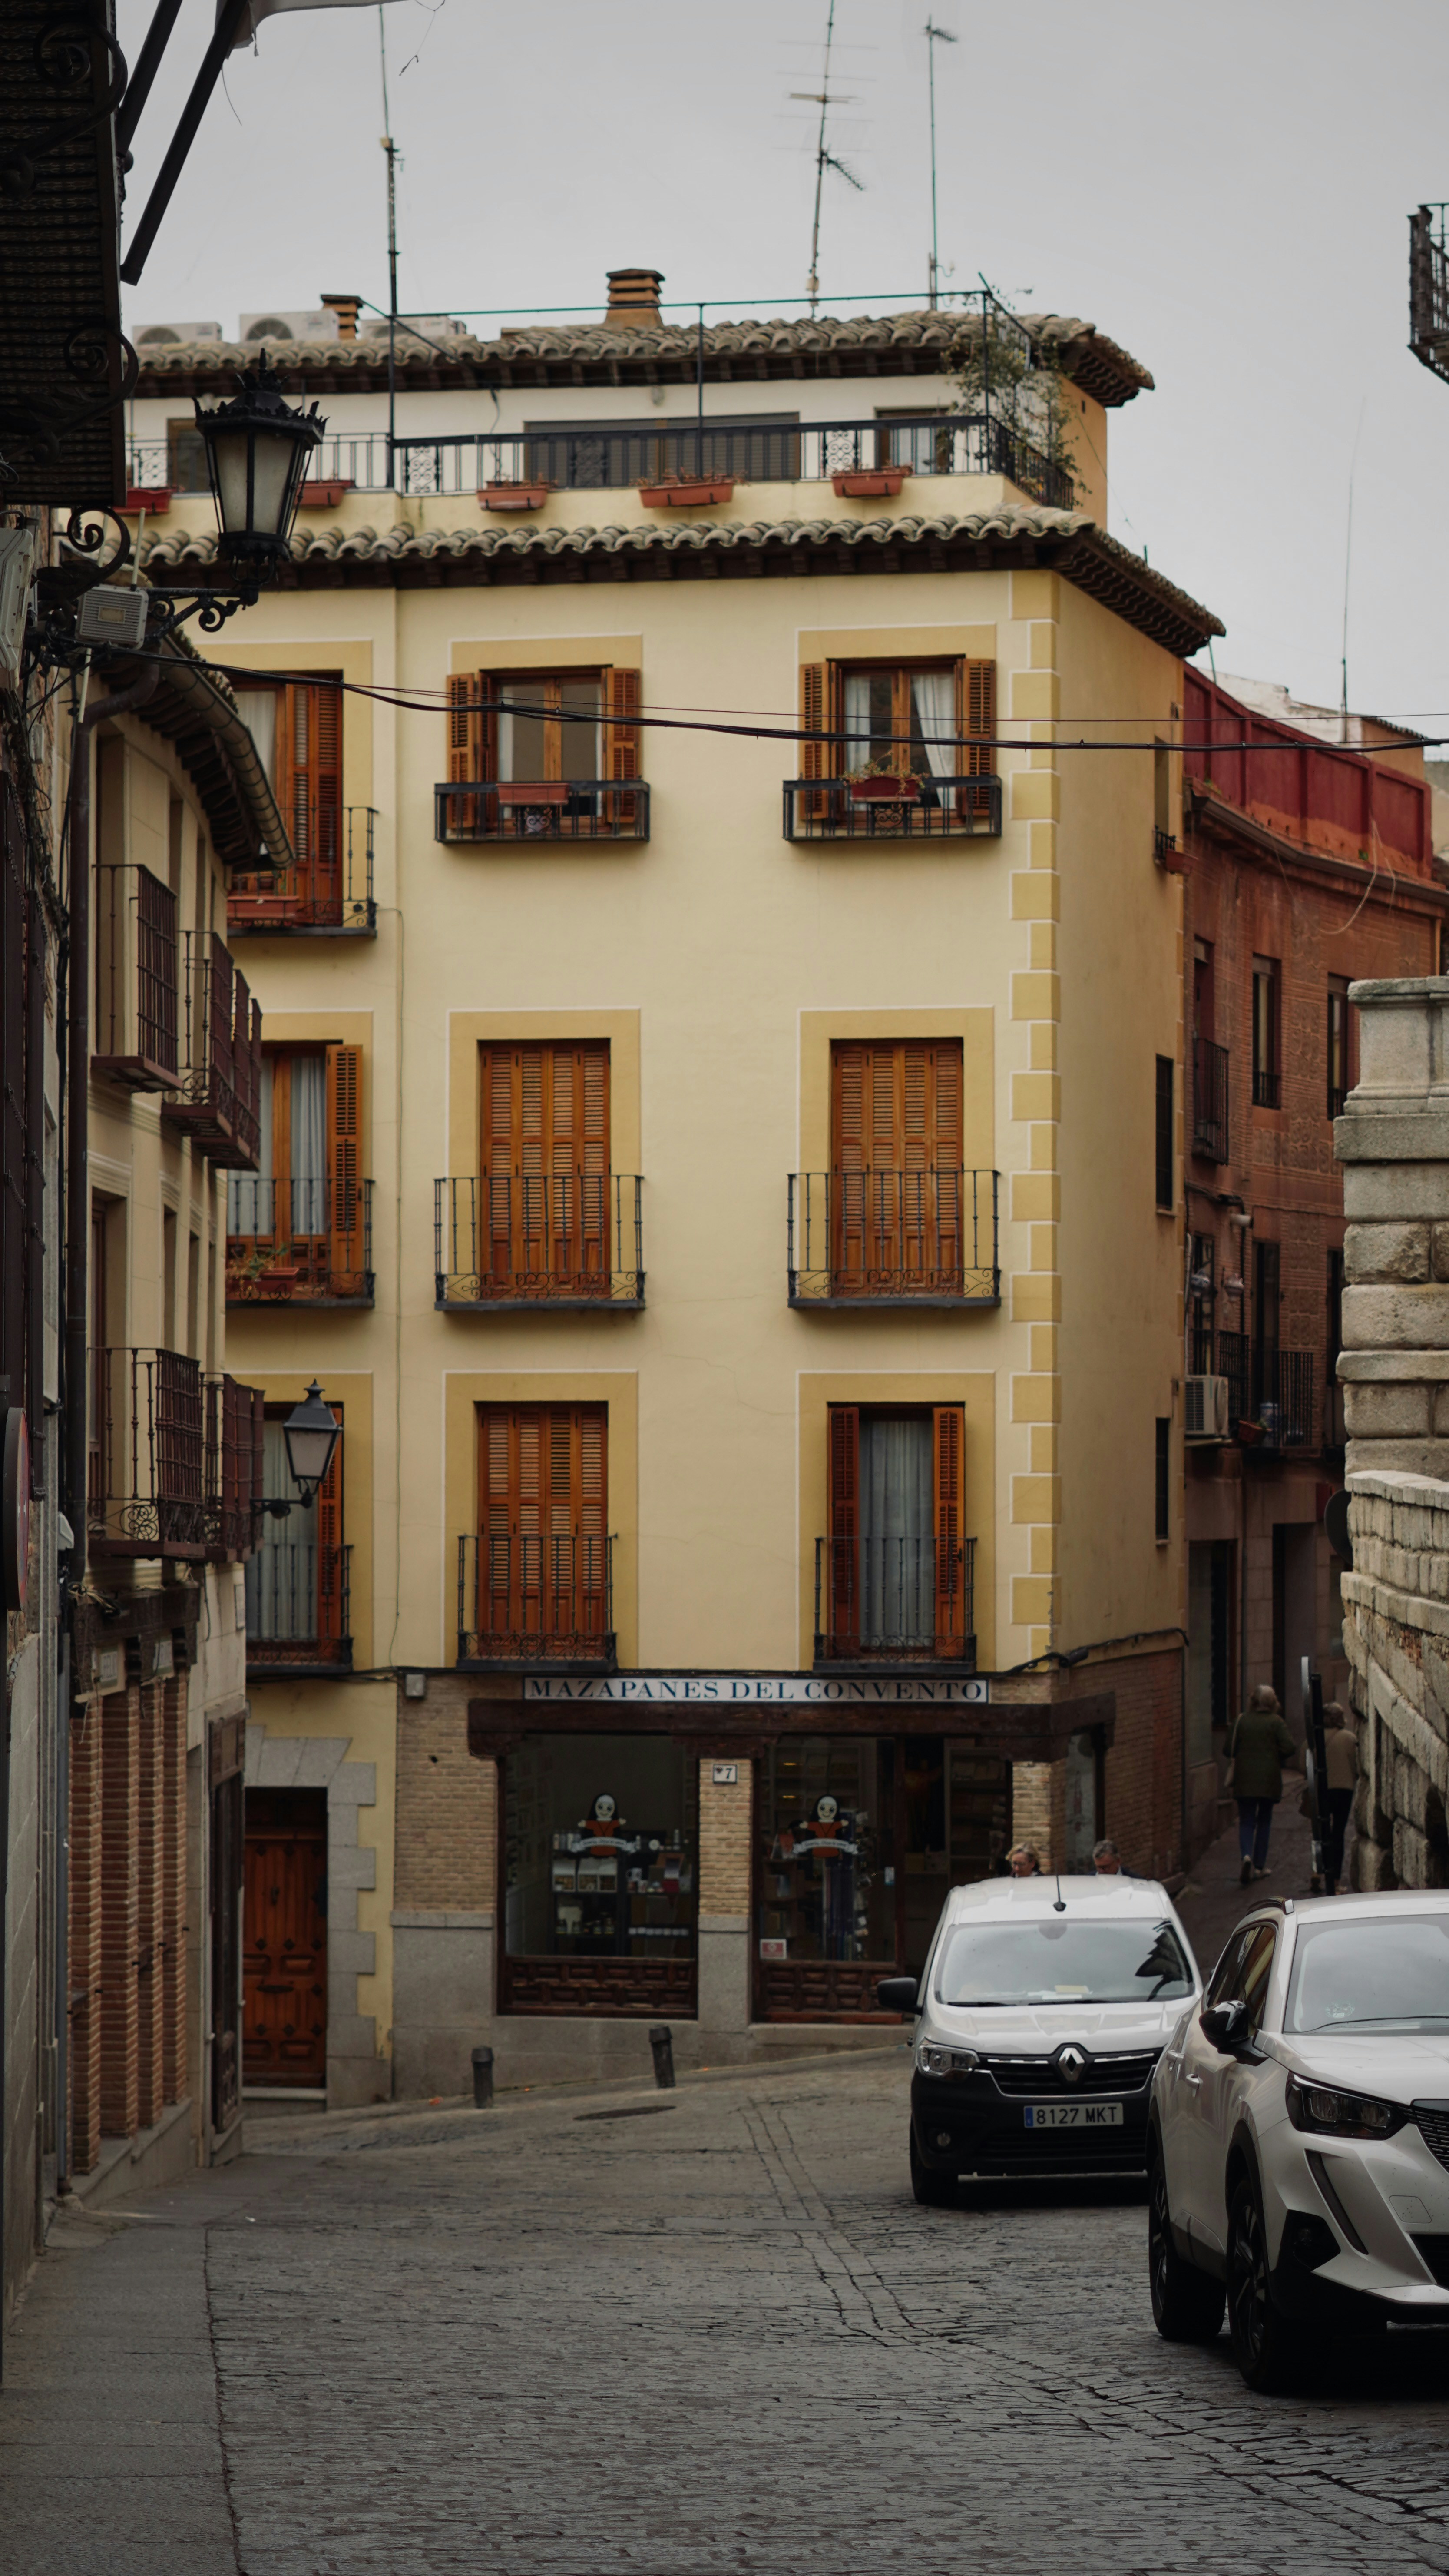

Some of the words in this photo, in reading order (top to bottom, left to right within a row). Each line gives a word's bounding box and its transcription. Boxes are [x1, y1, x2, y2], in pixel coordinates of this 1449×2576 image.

[529, 1680, 719, 1699] MAZAPANES
[729, 1681, 794, 1699] DEL
[805, 1681, 982, 1700] CONVENTO
[725, 1768, 733, 1780] 7
[1036, 2108, 1079, 2125] 8127
[1085, 2106, 1117, 2123] MKT
